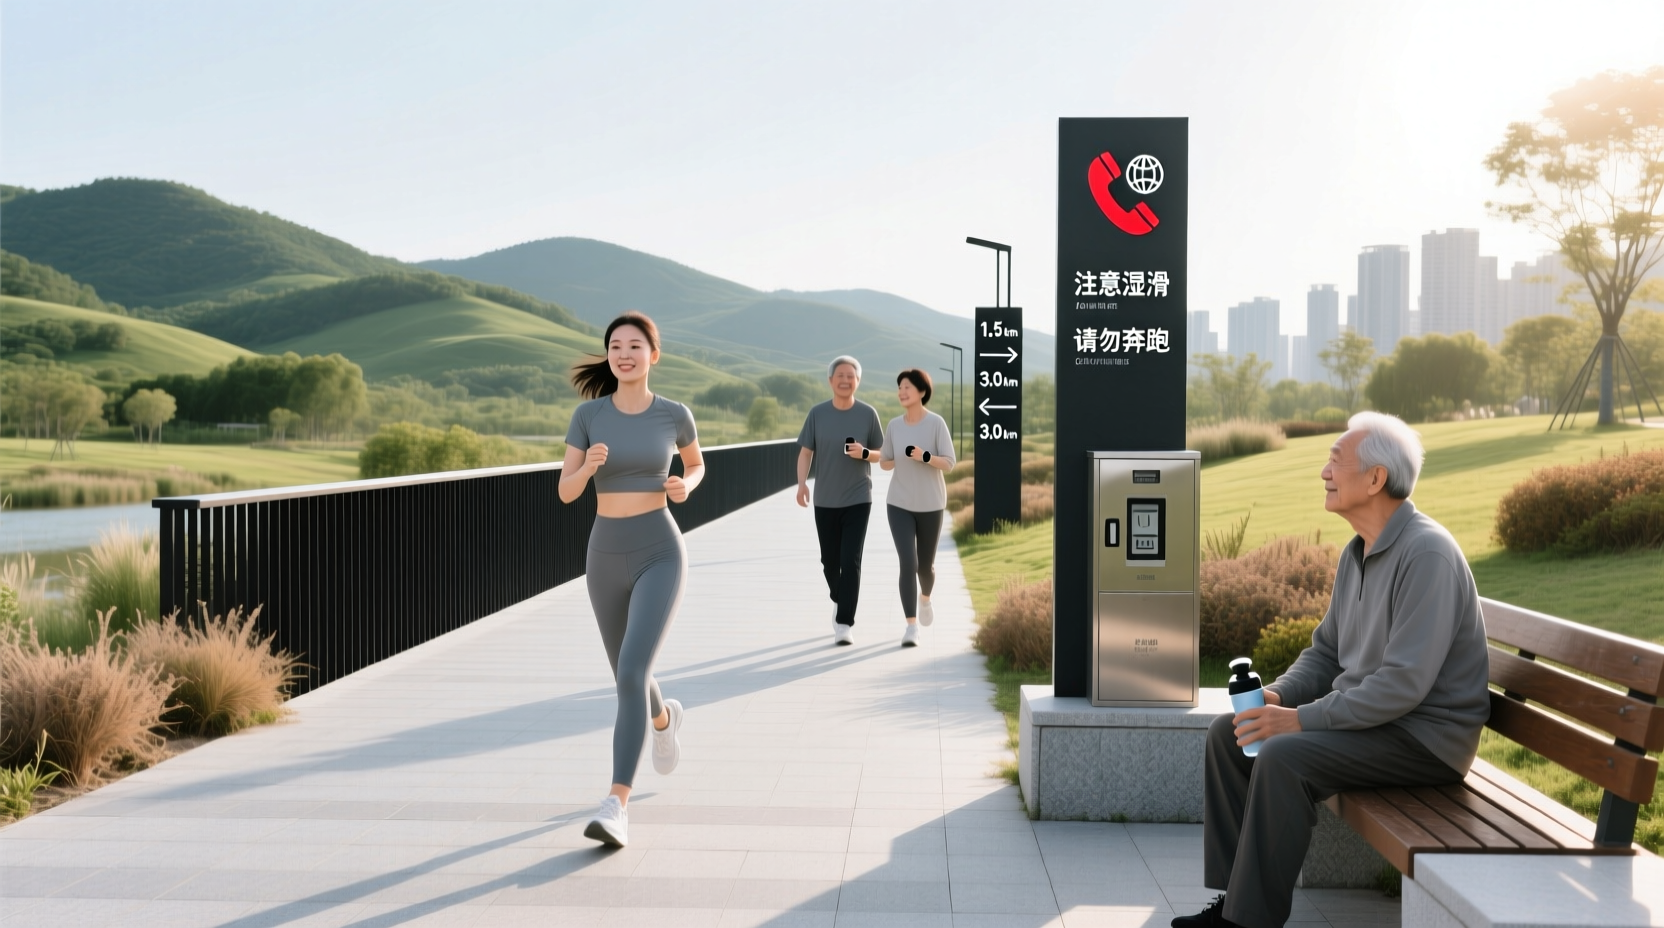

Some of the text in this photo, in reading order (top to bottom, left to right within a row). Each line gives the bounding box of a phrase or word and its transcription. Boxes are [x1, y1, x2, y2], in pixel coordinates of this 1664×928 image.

[1074, 270, 1170, 297] 注意湿滑
[1073, 326, 1170, 354] 请勿奔跑
